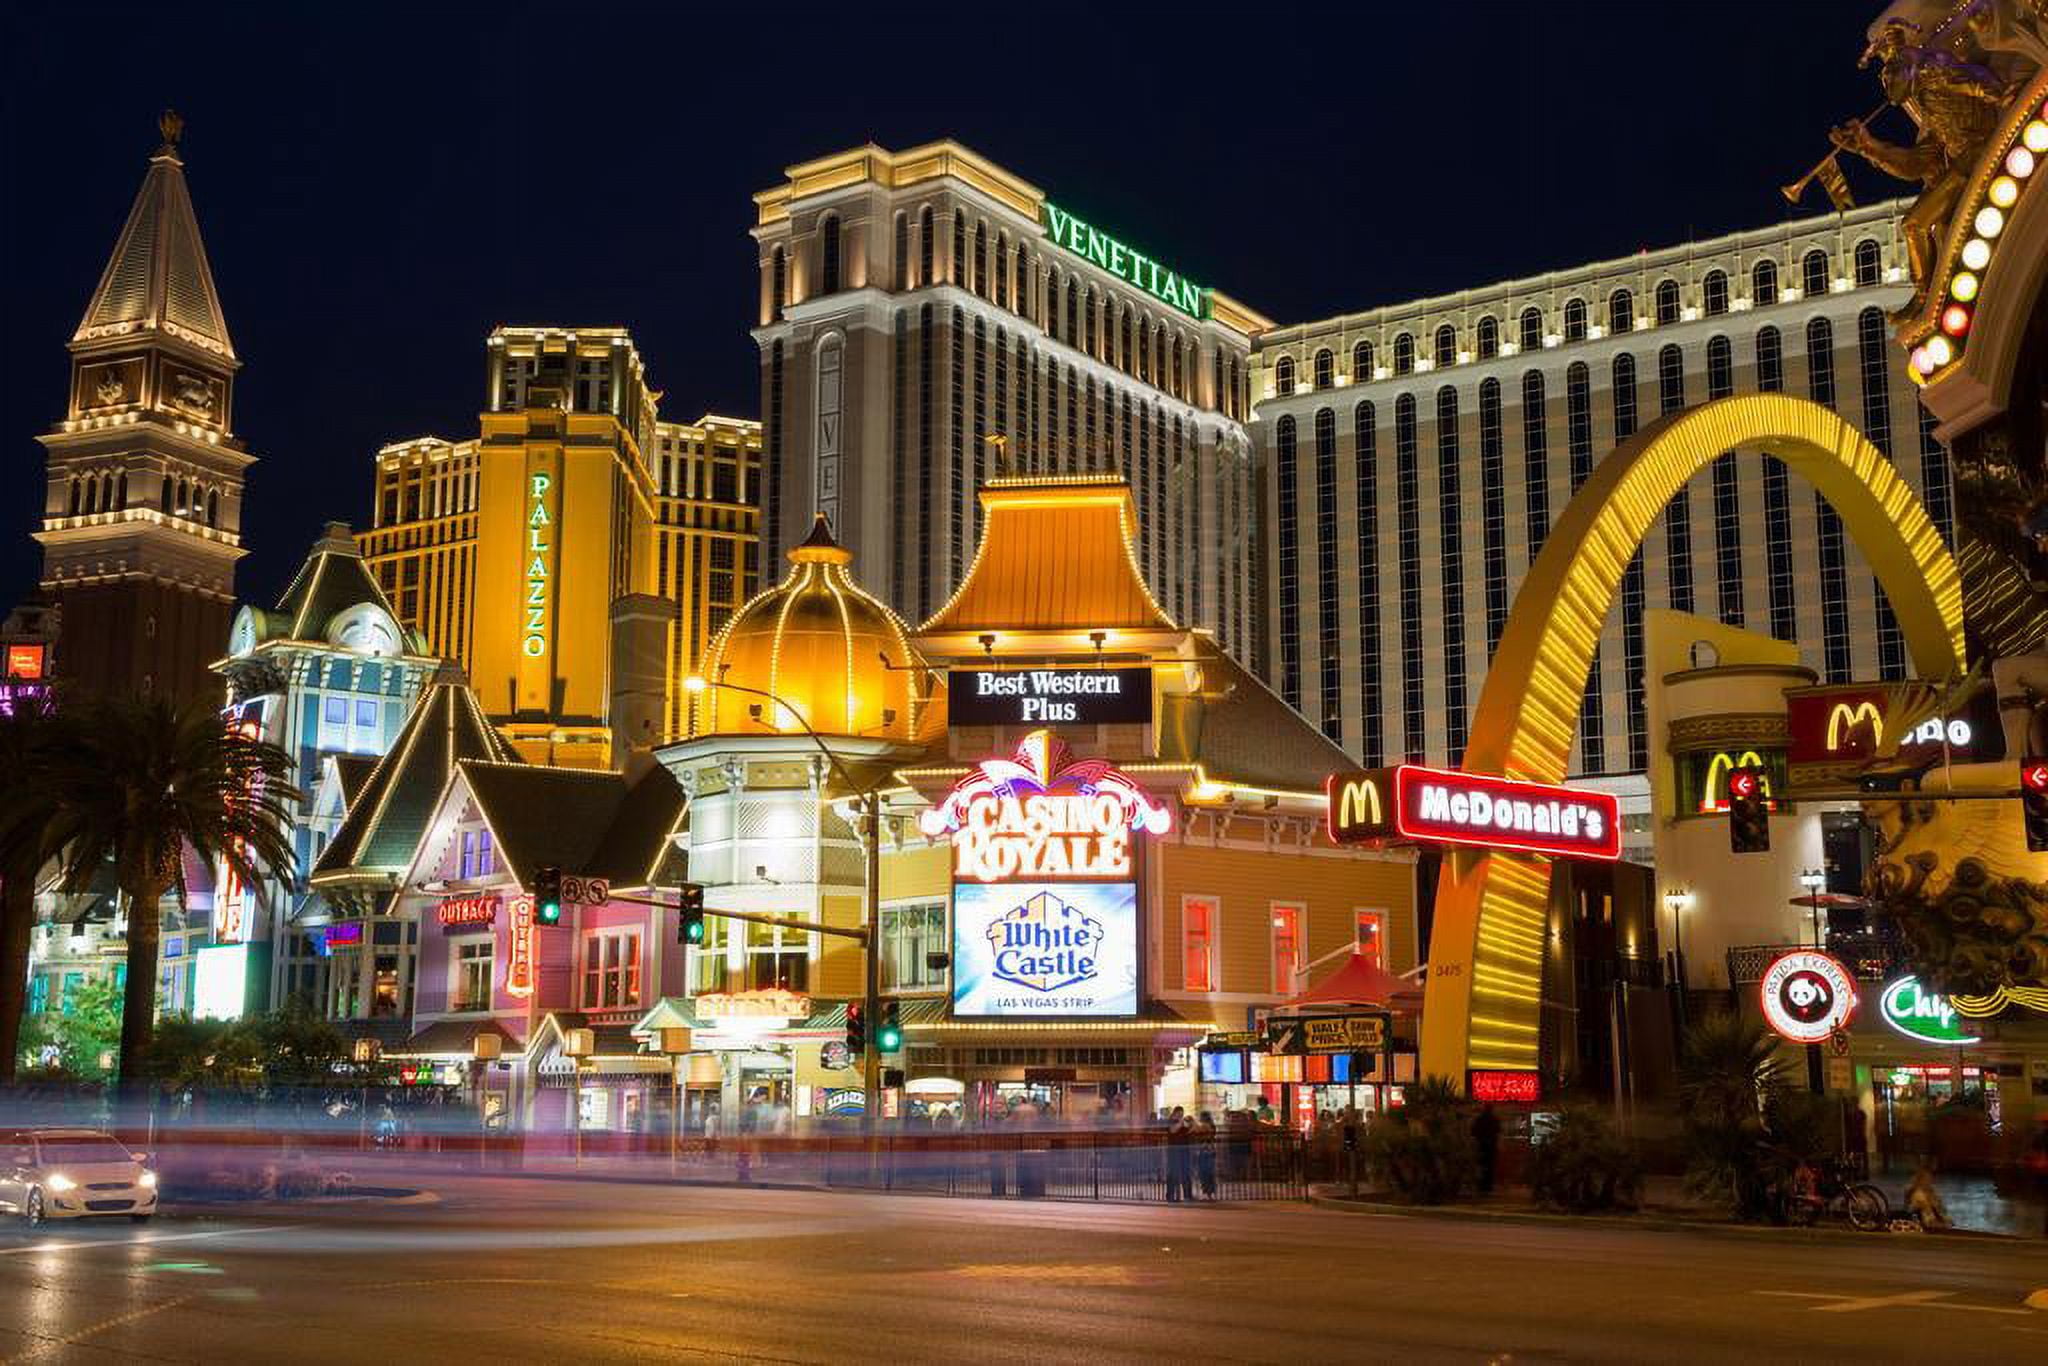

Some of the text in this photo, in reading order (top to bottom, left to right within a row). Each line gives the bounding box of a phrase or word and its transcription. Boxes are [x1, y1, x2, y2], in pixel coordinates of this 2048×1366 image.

[1047, 204, 1202, 318] VENETIAN
[523, 475, 550, 657] PALAZZO
[977, 671, 1121, 696] Best Western
[1022, 698, 1077, 721] Plus
[967, 795, 1124, 835] CASINO
[1339, 779, 1382, 829] M
[1419, 784, 1604, 839] McDonald's
[952, 829, 1131, 882] ROYALE
[438, 897, 494, 924] OUTBACK
[1002, 921, 1090, 952] White
[996, 950, 1095, 976] Castle
[997, 997, 1094, 1009] LAS VEGAS STRIP
